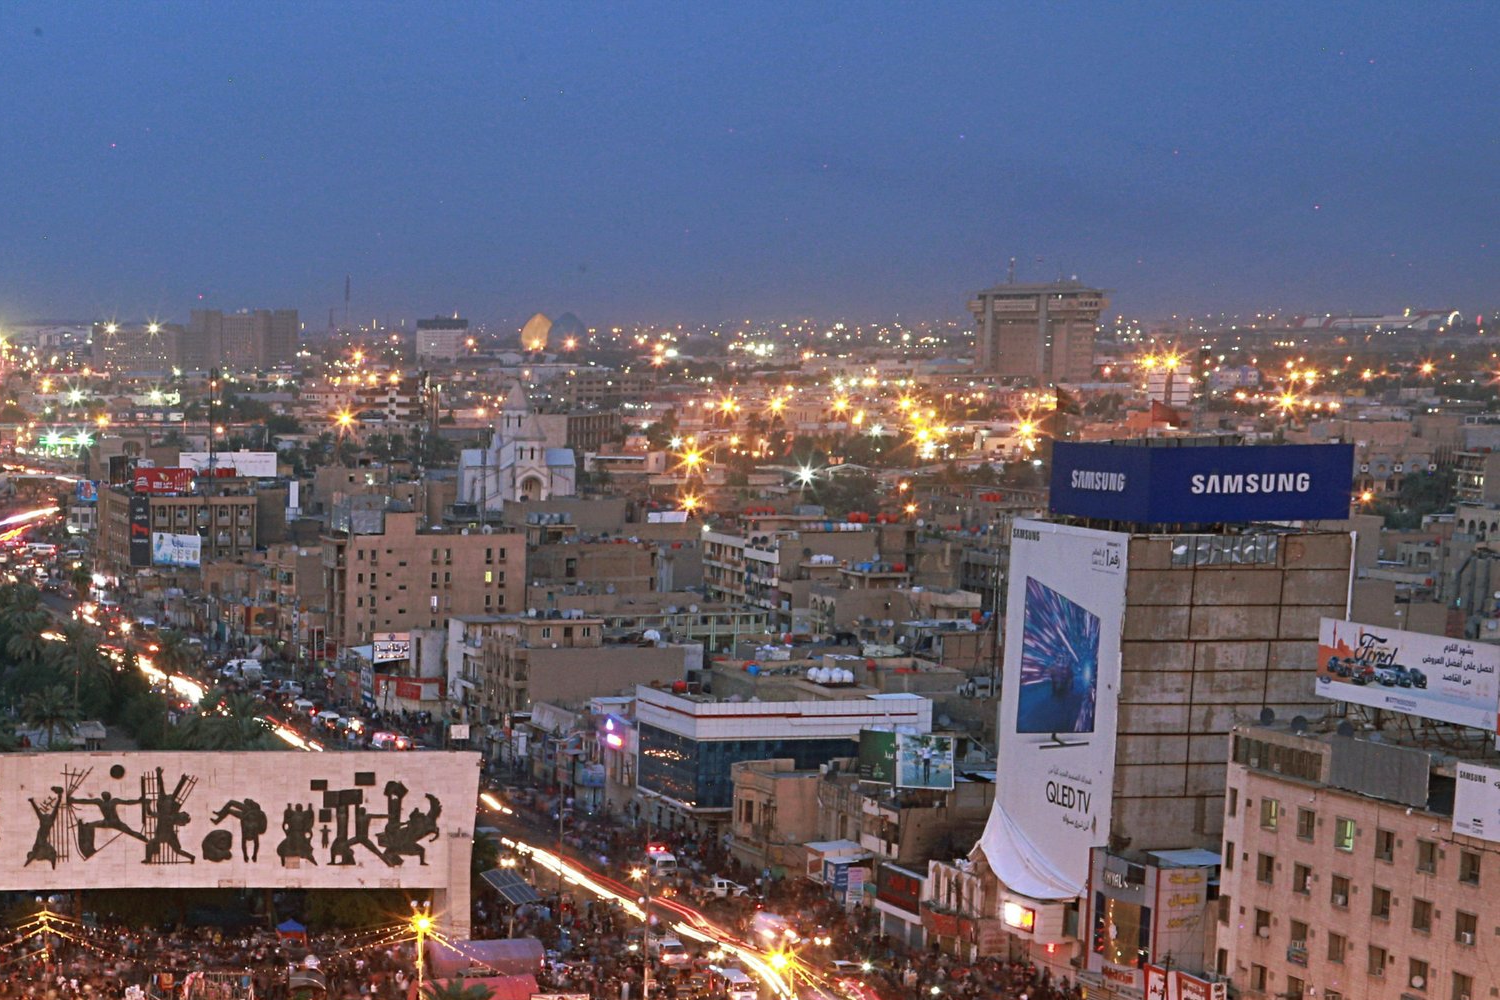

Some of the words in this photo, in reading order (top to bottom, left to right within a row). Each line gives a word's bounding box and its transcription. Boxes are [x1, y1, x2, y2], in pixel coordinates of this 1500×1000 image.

[1071, 470, 1126, 492] SAMSUNG
[1191, 473, 1311, 494] SAMSUNG
[1013, 528, 1040, 542] SAMSUNG
[1443, 643, 1459, 655] الكرم
[1422, 654, 1445, 666] العروض
[1459, 770, 1486, 784] SAMSUNG
[1046, 781, 1075, 809] QLED
[1077, 789, 1091, 814] TV
